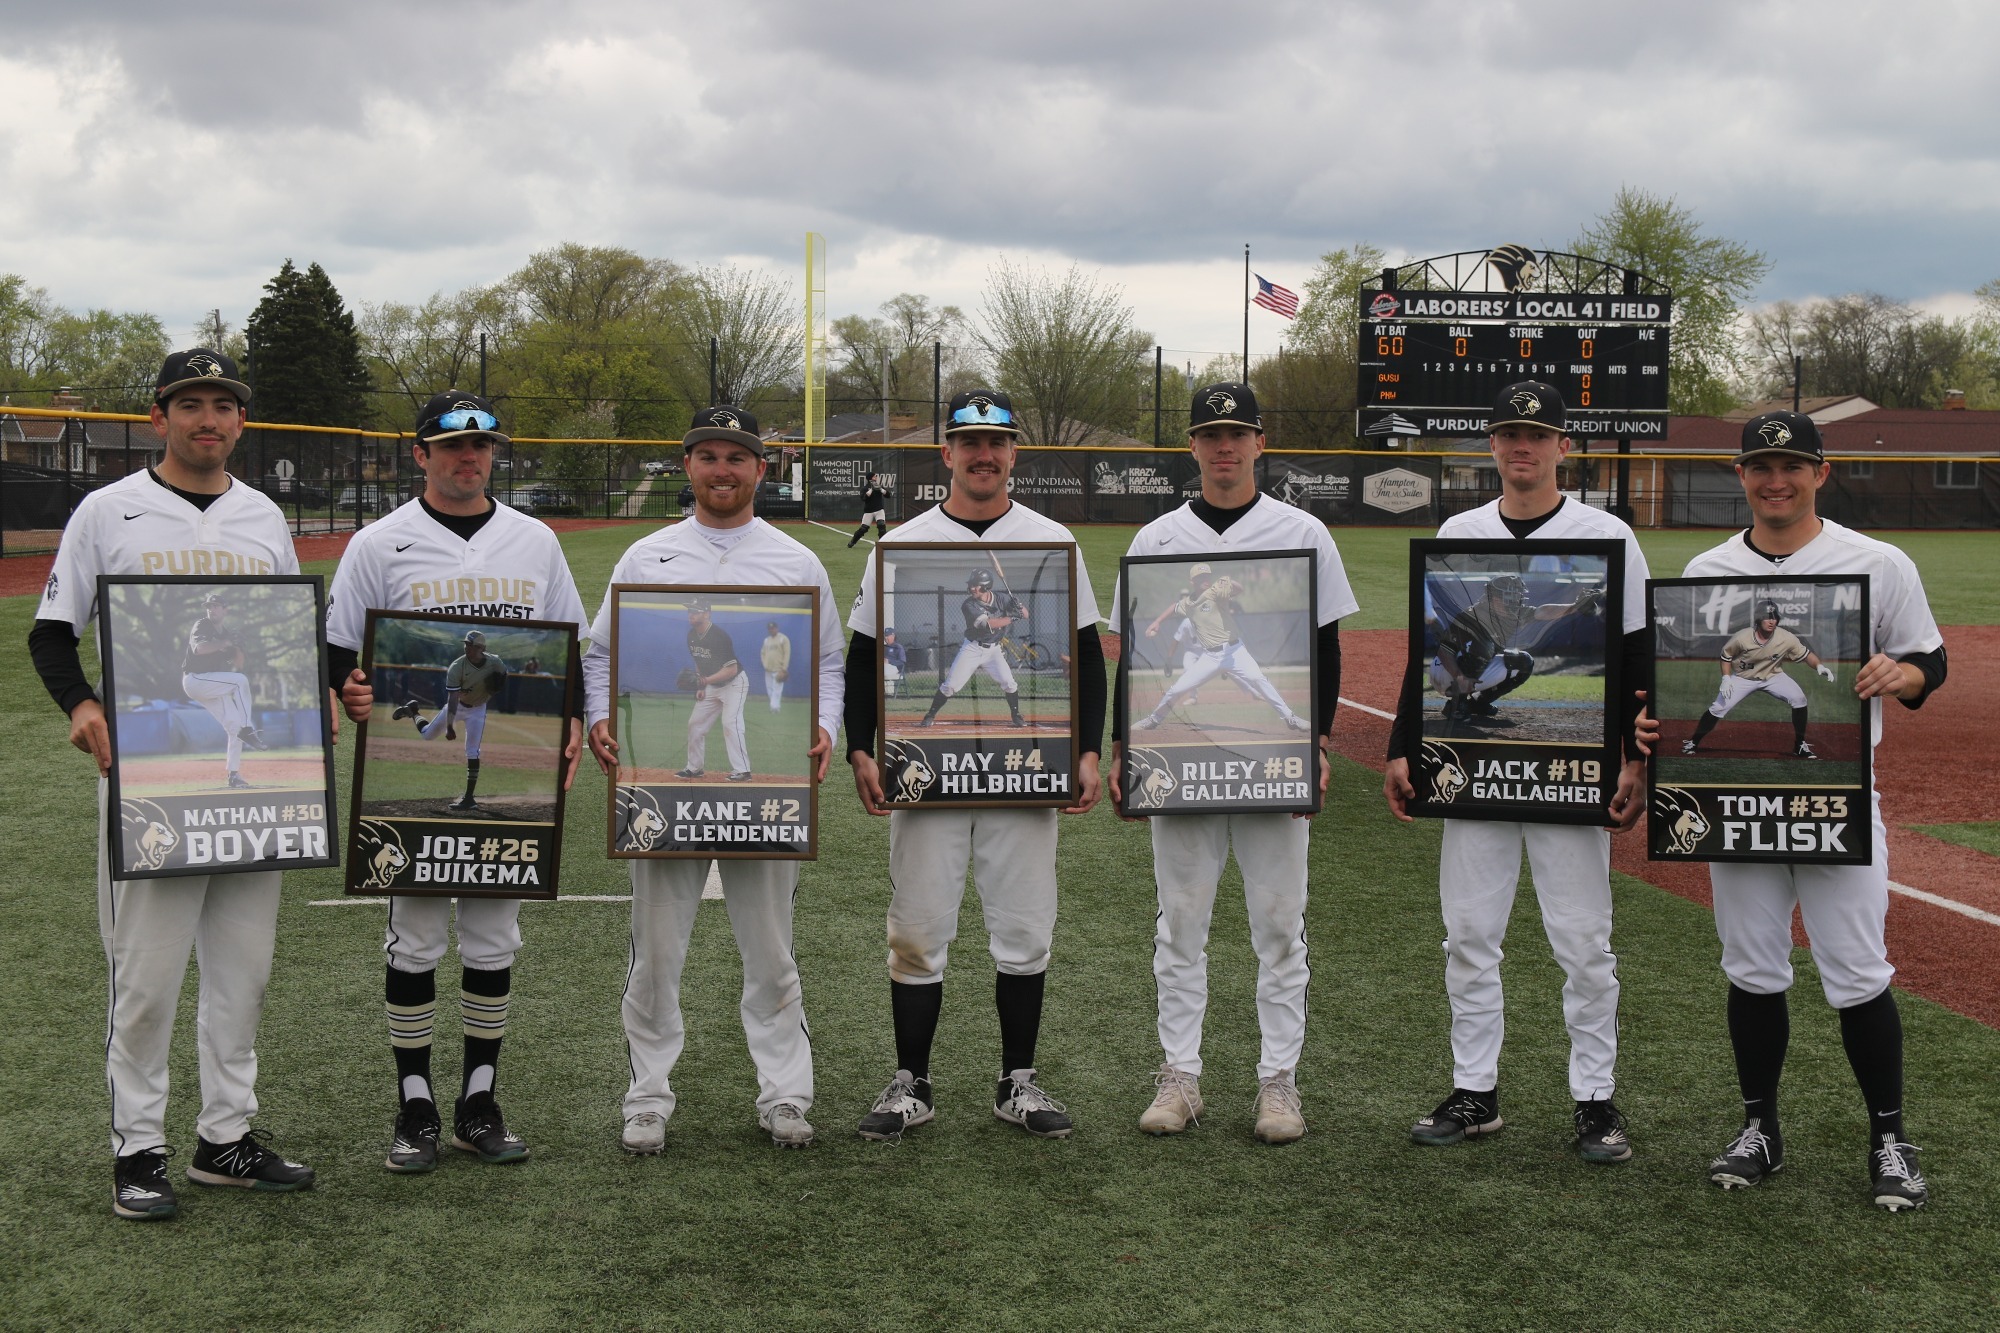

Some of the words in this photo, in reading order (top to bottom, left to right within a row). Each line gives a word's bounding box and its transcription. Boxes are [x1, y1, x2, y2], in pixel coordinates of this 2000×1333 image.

[1404, 299, 1510, 317] LABORERS'
[1515, 301, 1577, 317] LOCAL
[1581, 302, 1602, 318] 41
[1610, 302, 1660, 319] FIELD
[1374, 325, 1387, 336] AT
[1389, 325, 1407, 336] BAT
[1449, 326, 1473, 337] BALL
[1509, 327, 1544, 339] STRIKE
[1577, 328, 1597, 339] OUT
[1638, 329, 1655, 341] H/E
[1378, 336, 1403, 356] 60
[1455, 337, 1467, 357] 0
[1520, 339, 1531, 358] 0
[1581, 339, 1593, 359] 0
[1422, 363, 1428, 371] 1
[1435, 363, 1441, 372] 2
[1448, 363, 1455, 372] 3
[1464, 363, 1470, 372] 4
[1477, 363, 1483, 373] 5
[1490, 363, 1496, 373] 6
[1506, 364, 1511, 373] 7
[1518, 364, 1524, 373] 8
[1531, 364, 1538, 373] 9
[1544, 364, 1556, 374] 10
[1570, 365, 1593, 374] RUNS
[1608, 365, 1627, 375] HITS
[1642, 365, 1659, 375] ERR
[1378, 373, 1400, 382] GVSU
[1581, 374, 1591, 389] 0
[1581, 391, 1591, 406] 0
[1426, 418, 1489, 431] PURDUE
[1566, 420, 1611, 433] CREDIT
[1614, 421, 1661, 433] UNION
[824, 475, 852, 483] WORKS
[1128, 467, 1156, 477] KRAZY
[1016, 477, 1035, 486] NW
[1038, 477, 1082, 486] INDIANA
[1128, 476, 1169, 486] KAPLAN'S
[1374, 477, 1420, 489] Hampton
[914, 484, 948, 501] JED
[1016, 487, 1031, 495] 24/7
[1049, 487, 1084, 495] HOSPITAL
[1128, 485, 1175, 495] FIREWORKS
[1182, 490, 1203, 498] PUR
[1372, 488, 1392, 498] Inn
[1400, 488, 1423, 498] Suites
[410, 577, 536, 608] PURDUE
[1756, 587, 1794, 600] Holiday
[1794, 587, 1811, 599] Inn
[413, 603, 534, 620] RTHWEST
[941, 752, 995, 772] RAY
[1004, 748, 1044, 771] #4
[1182, 760, 1257, 781] RILEY
[1263, 756, 1303, 779] #8
[1473, 759, 1540, 780] JACK
[1547, 759, 1601, 783] #19
[941, 773, 1069, 794] HILBRICH
[1181, 782, 1309, 801] GALLAGHER
[1472, 782, 1601, 804] GALLAGHER
[675, 801, 752, 821] KANE
[760, 799, 800, 822] #2
[1717, 795, 1784, 817] TOM
[1789, 795, 1848, 818] #33
[183, 805, 277, 827] NATHAN
[281, 803, 324, 822] #30
[674, 824, 809, 842] CLENDENEN
[1722, 821, 1848, 852] FLISK
[185, 825, 327, 865] BOYER
[416, 835, 476, 860] JOE
[479, 837, 539, 862] #26
[414, 862, 540, 885] BUIKEMA
